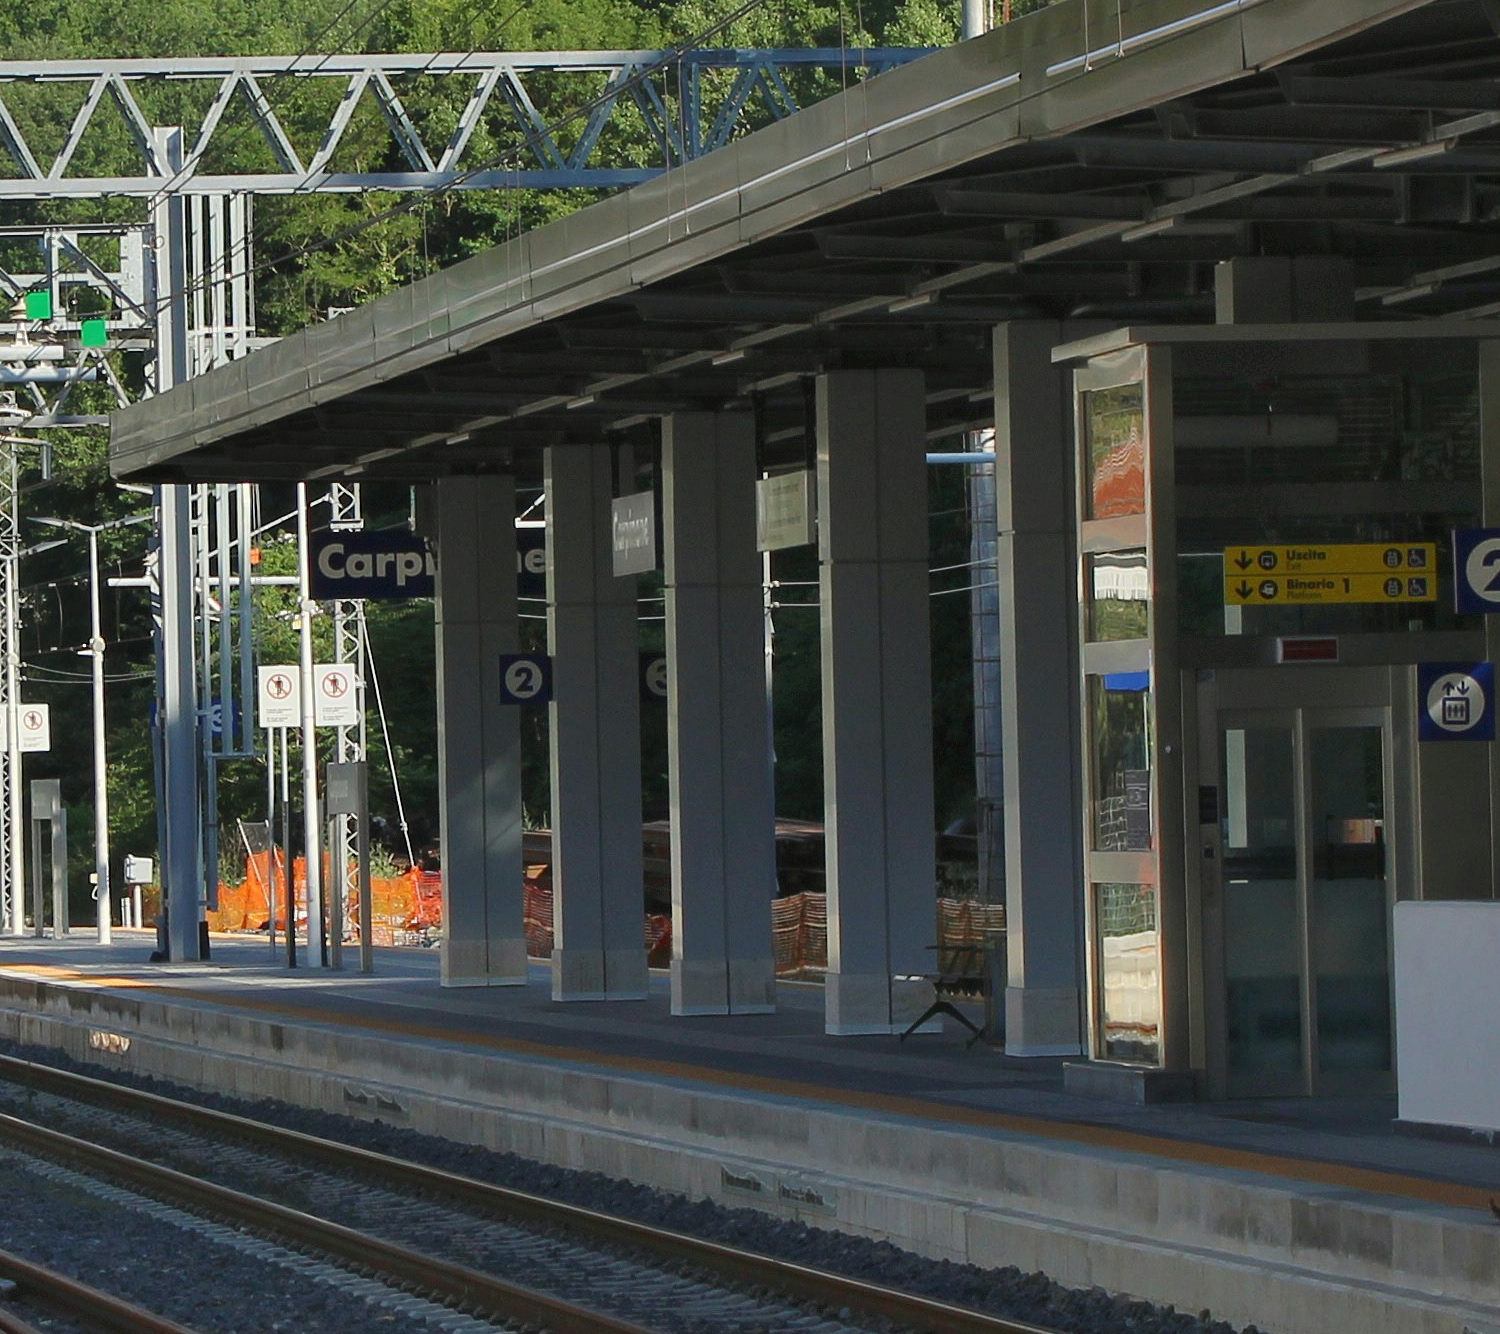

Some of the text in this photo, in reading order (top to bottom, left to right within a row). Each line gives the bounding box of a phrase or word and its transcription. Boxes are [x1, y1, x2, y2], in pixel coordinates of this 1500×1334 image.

[1286, 549, 1327, 562] Uscita
[1287, 577, 1351, 594] Binario 1
[514, 667, 534, 692] 2
